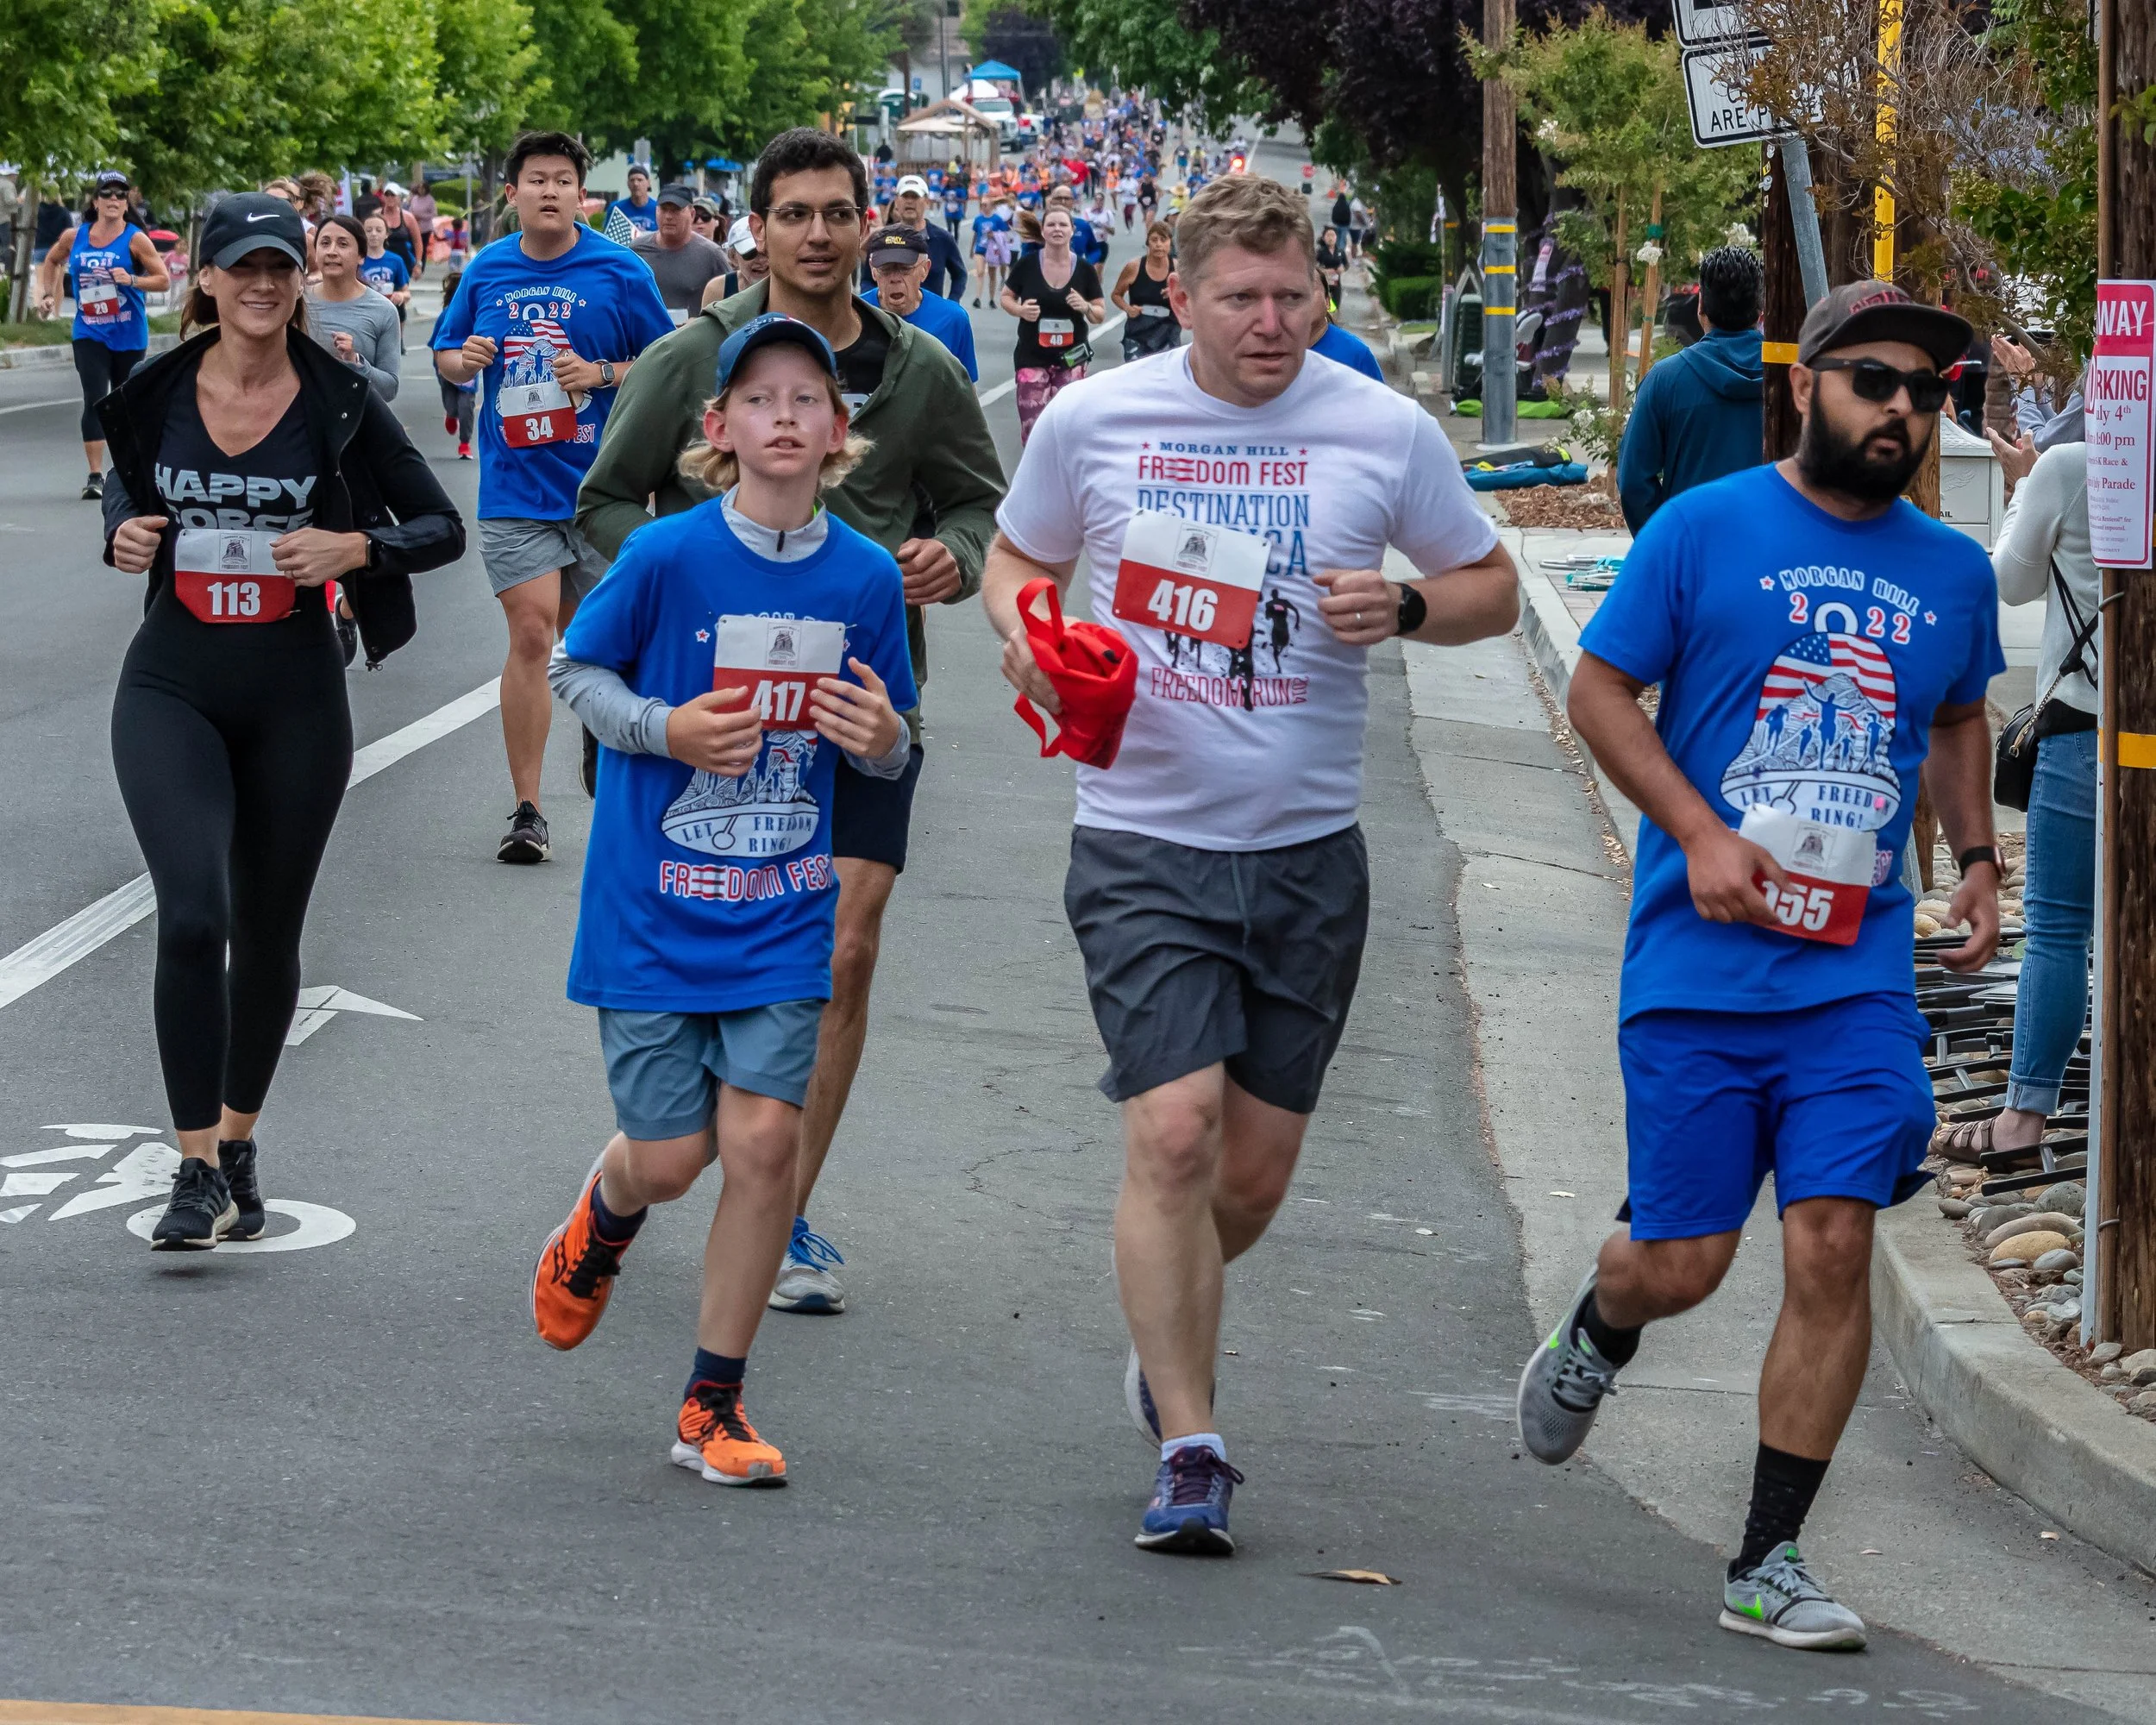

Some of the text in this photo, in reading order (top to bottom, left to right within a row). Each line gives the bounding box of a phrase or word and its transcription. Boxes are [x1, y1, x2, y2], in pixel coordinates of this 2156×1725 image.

[1711, 107, 1747, 132] ARE
[505, 285, 577, 303] MORGAN HILL
[525, 416, 555, 441] 34
[1160, 442, 1289, 457] MORGAN HILL
[2114, 436, 2136, 450] pm
[1260, 461, 1309, 486] FEST
[2103, 457, 2120, 466] Race
[2121, 457, 2128, 467] &
[155, 462, 317, 511] HAPPY
[2102, 477, 2136, 490] Parade
[1138, 489, 1310, 528] DESTINATION
[207, 581, 261, 616] 113
[1778, 566, 1920, 617] MORGAN HILL
[1148, 579, 1219, 632] 416
[1151, 667, 1290, 707] FREEDOM RUN
[749, 680, 806, 722] 417
[1740, 785, 1891, 817] LET FREEDM
[682, 816, 812, 843] LET FREEDOM
[1811, 806, 1864, 829] RING!
[749, 837, 793, 853] RING!
